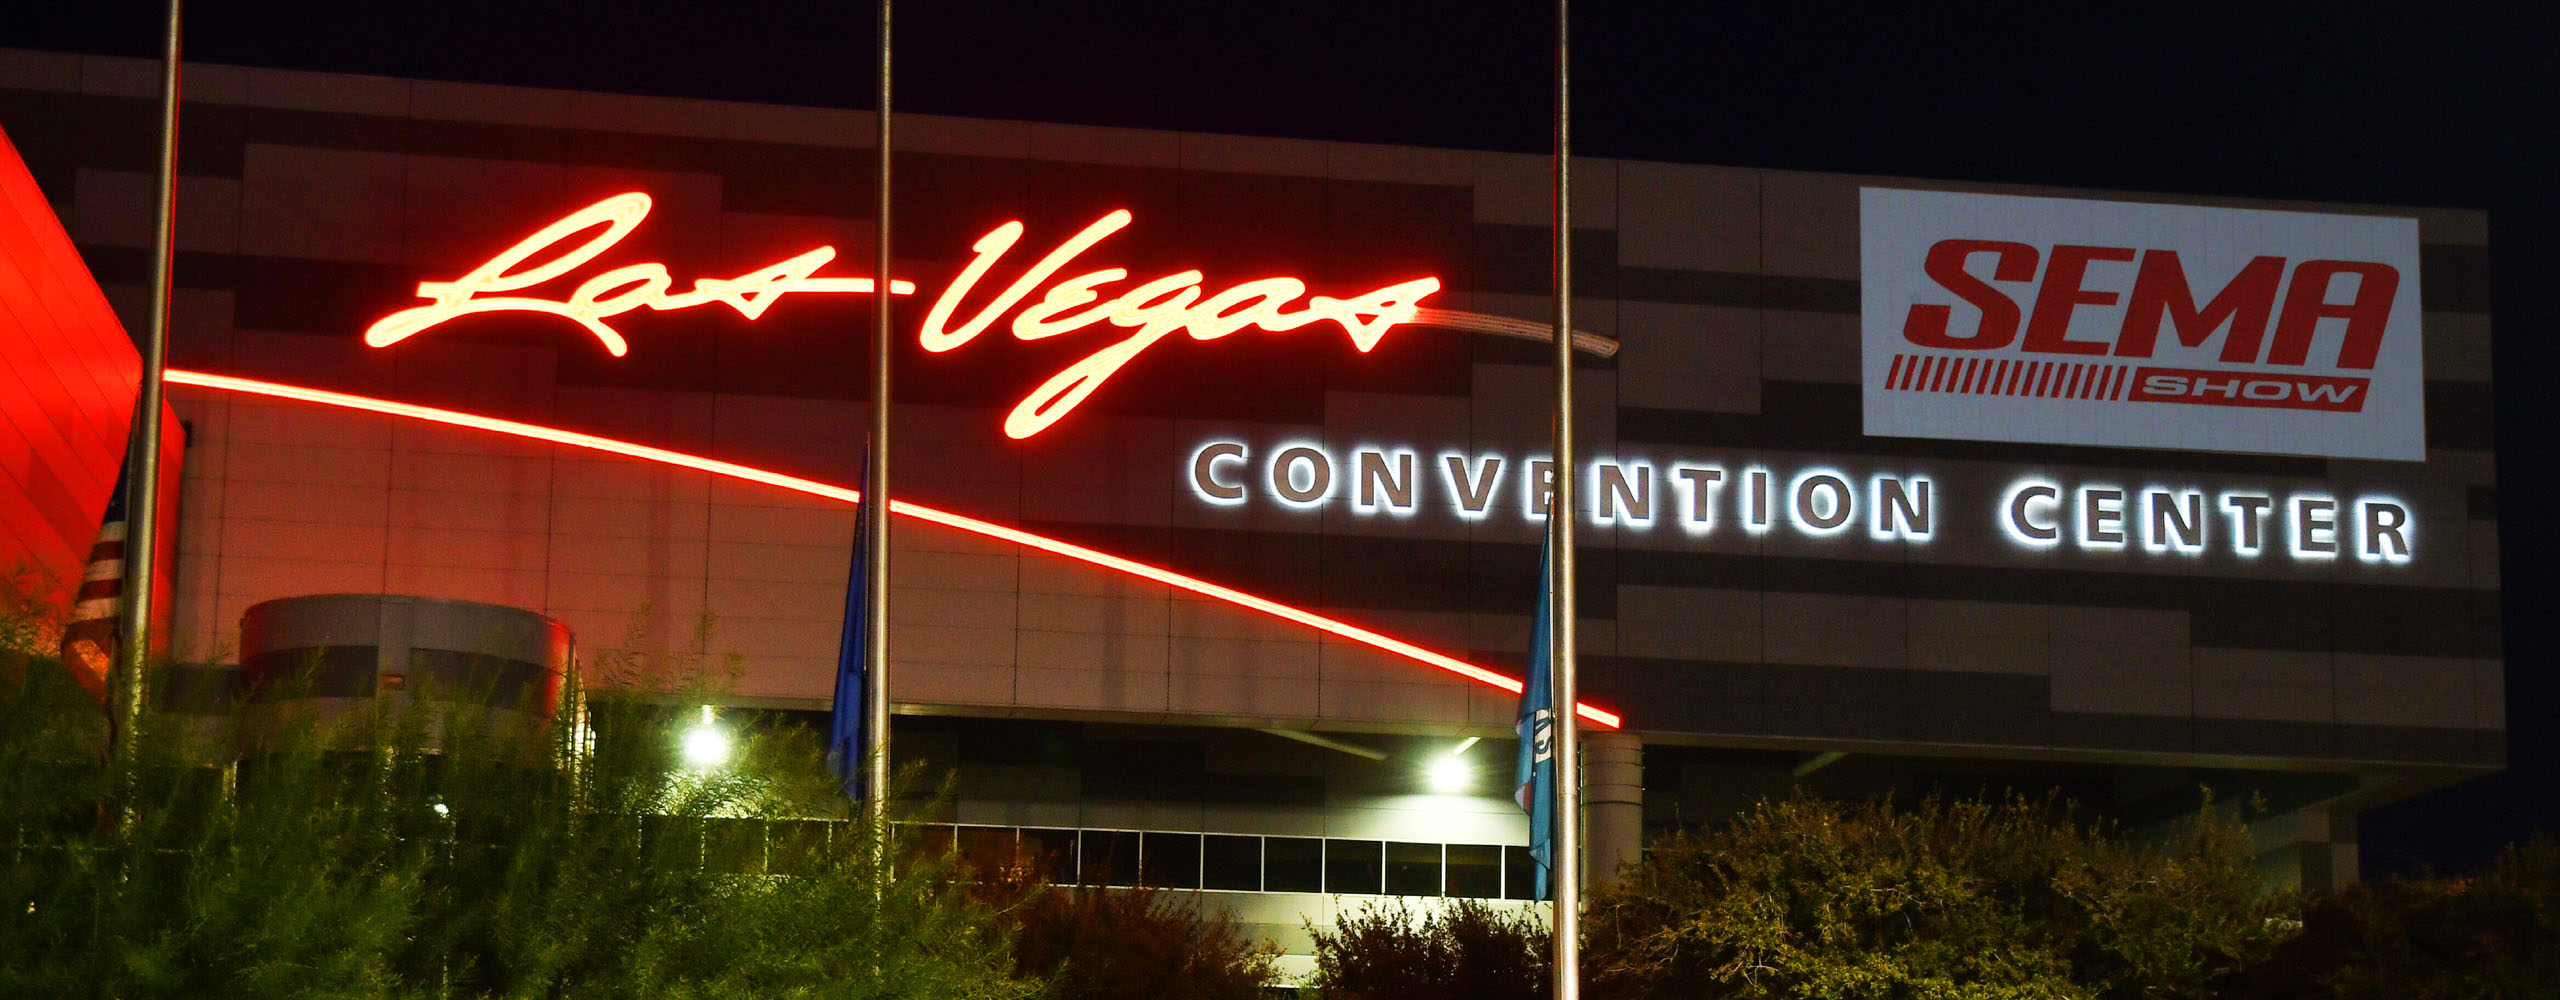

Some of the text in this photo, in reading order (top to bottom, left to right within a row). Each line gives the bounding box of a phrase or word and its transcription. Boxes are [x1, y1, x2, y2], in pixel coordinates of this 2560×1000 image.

[364, 191, 1620, 440] Las Vegas
[1902, 238, 2401, 370] SEMA
[2141, 375, 2360, 404] SHOW
[1193, 442, 2410, 556] CONVENTION CENTER
